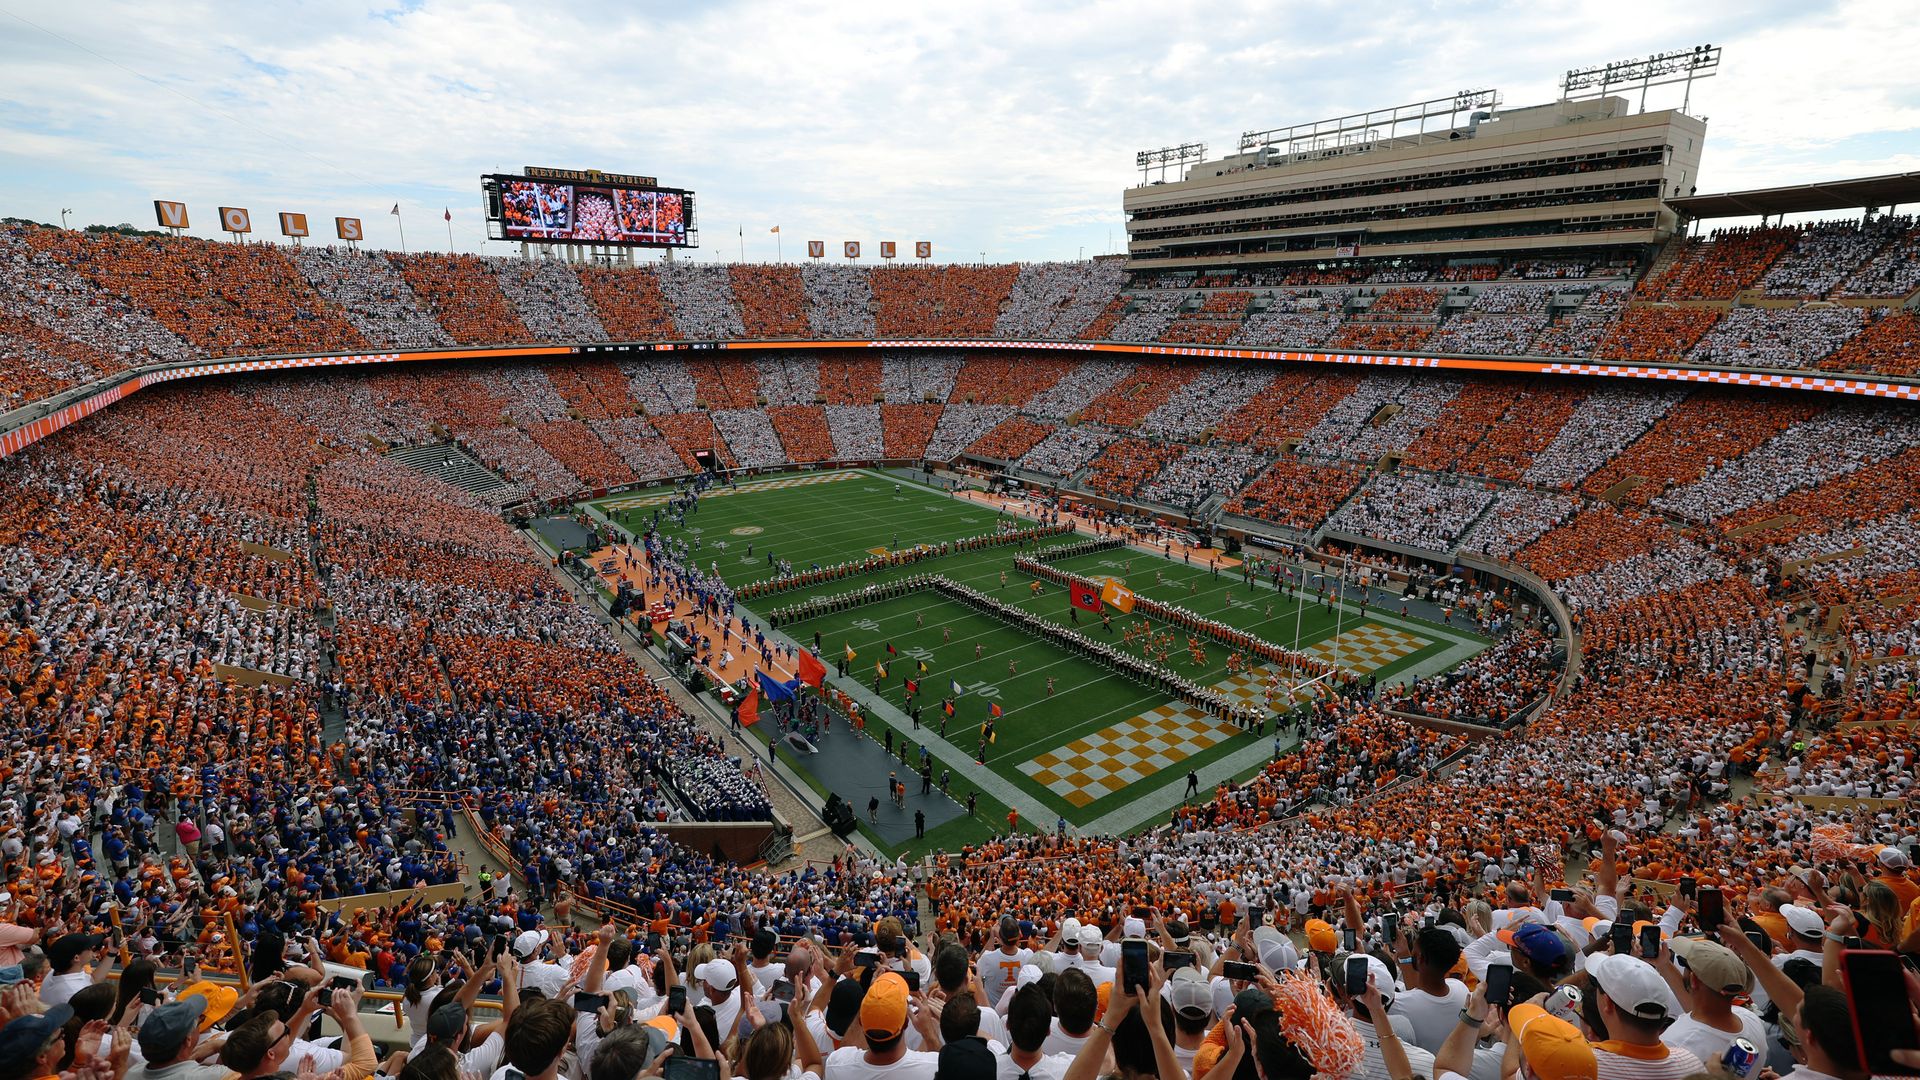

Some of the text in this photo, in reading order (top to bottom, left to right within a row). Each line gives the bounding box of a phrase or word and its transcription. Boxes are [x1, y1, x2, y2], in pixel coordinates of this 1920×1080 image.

[530, 167, 586, 180] NEYLAND
[604, 174, 656, 185] STADIUM
[1141, 346, 1440, 368] IT'S FOOTBALL TIME IN TENNESSEE
[47, 410, 72, 434] TIME
[72, 402, 83, 421] IN
[1112, 586, 1130, 606] T
[852, 618, 880, 631] 30
[901, 647, 934, 661] 20
[964, 680, 1000, 697] 10
[999, 961, 1020, 982] T
